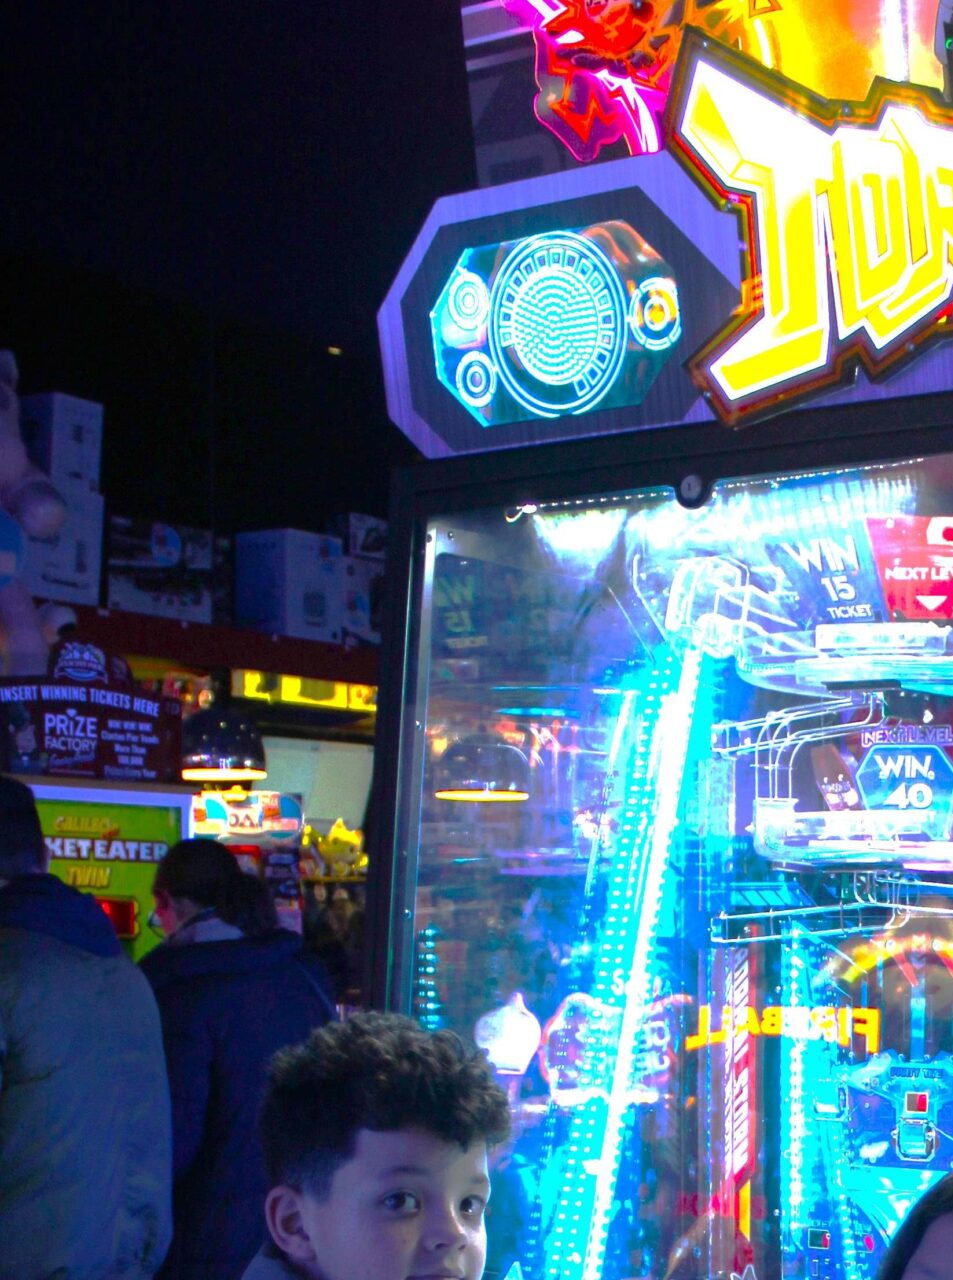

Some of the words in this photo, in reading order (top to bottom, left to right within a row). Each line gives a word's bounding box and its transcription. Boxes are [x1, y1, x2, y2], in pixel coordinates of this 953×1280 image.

[781, 535, 860, 575] WIN
[885, 566, 928, 581] NEXT
[821, 575, 857, 602] 15
[827, 603, 872, 619] TICKET
[0, 685, 37, 702] INSERT
[41, 685, 87, 702] WINNING
[90, 688, 131, 710] TICKETS
[133, 697, 160, 718] HERE
[44, 737, 97, 751] FACTORY
[874, 754, 933, 780] WIN
[882, 781, 934, 810] 40
[43, 837, 89, 859] KET
[94, 839, 169, 862] EATER
[66, 865, 111, 888] TWIN
